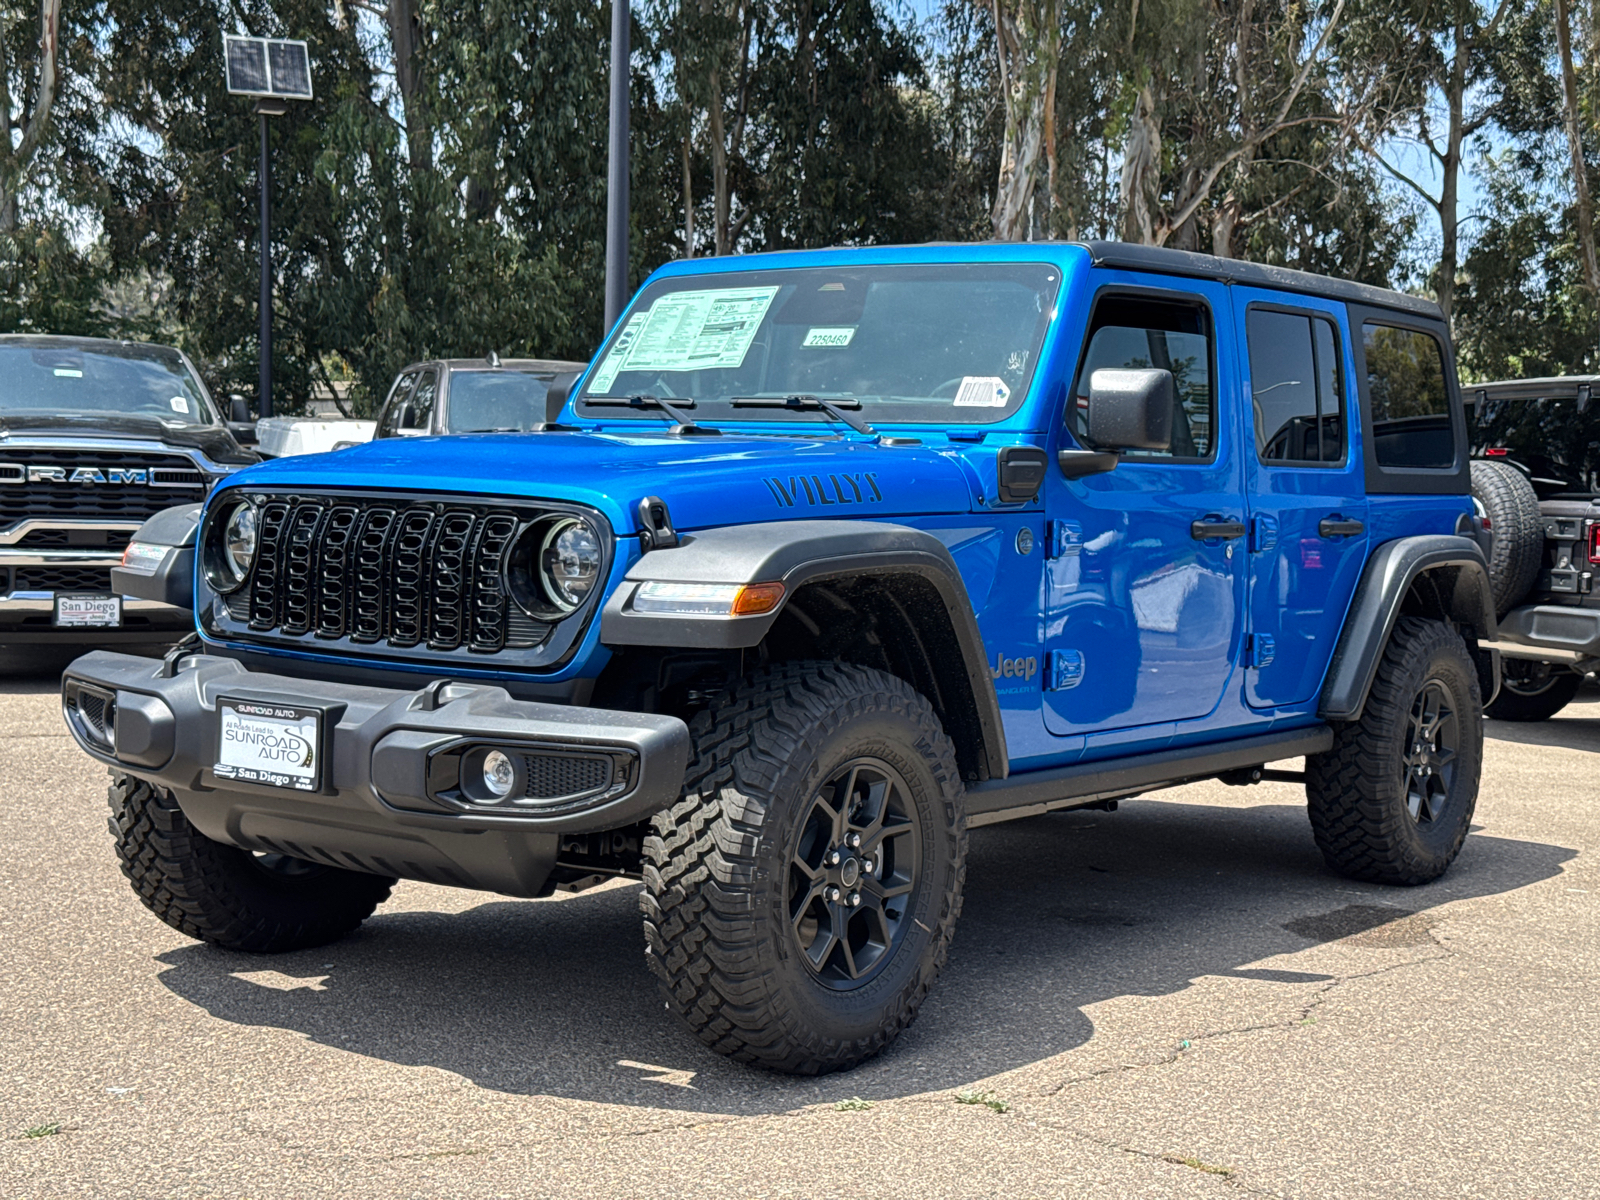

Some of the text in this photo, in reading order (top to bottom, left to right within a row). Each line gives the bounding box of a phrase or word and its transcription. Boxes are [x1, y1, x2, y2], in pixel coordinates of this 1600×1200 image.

[810, 334, 848, 345] 2250460
[27, 465, 147, 484] RAM
[762, 472, 883, 507] WILLYS
[61, 600, 116, 615] San Diego
[990, 653, 1037, 681] Jeep
[238, 704, 296, 718] SUNROAD AUTO
[234, 722, 251, 731] Roads
[252, 725, 266, 734] Lead
[225, 729, 301, 751] SUNROAD
[258, 747, 301, 763] AUTO
[238, 768, 257, 779] San
[259, 771, 290, 786] Diego
